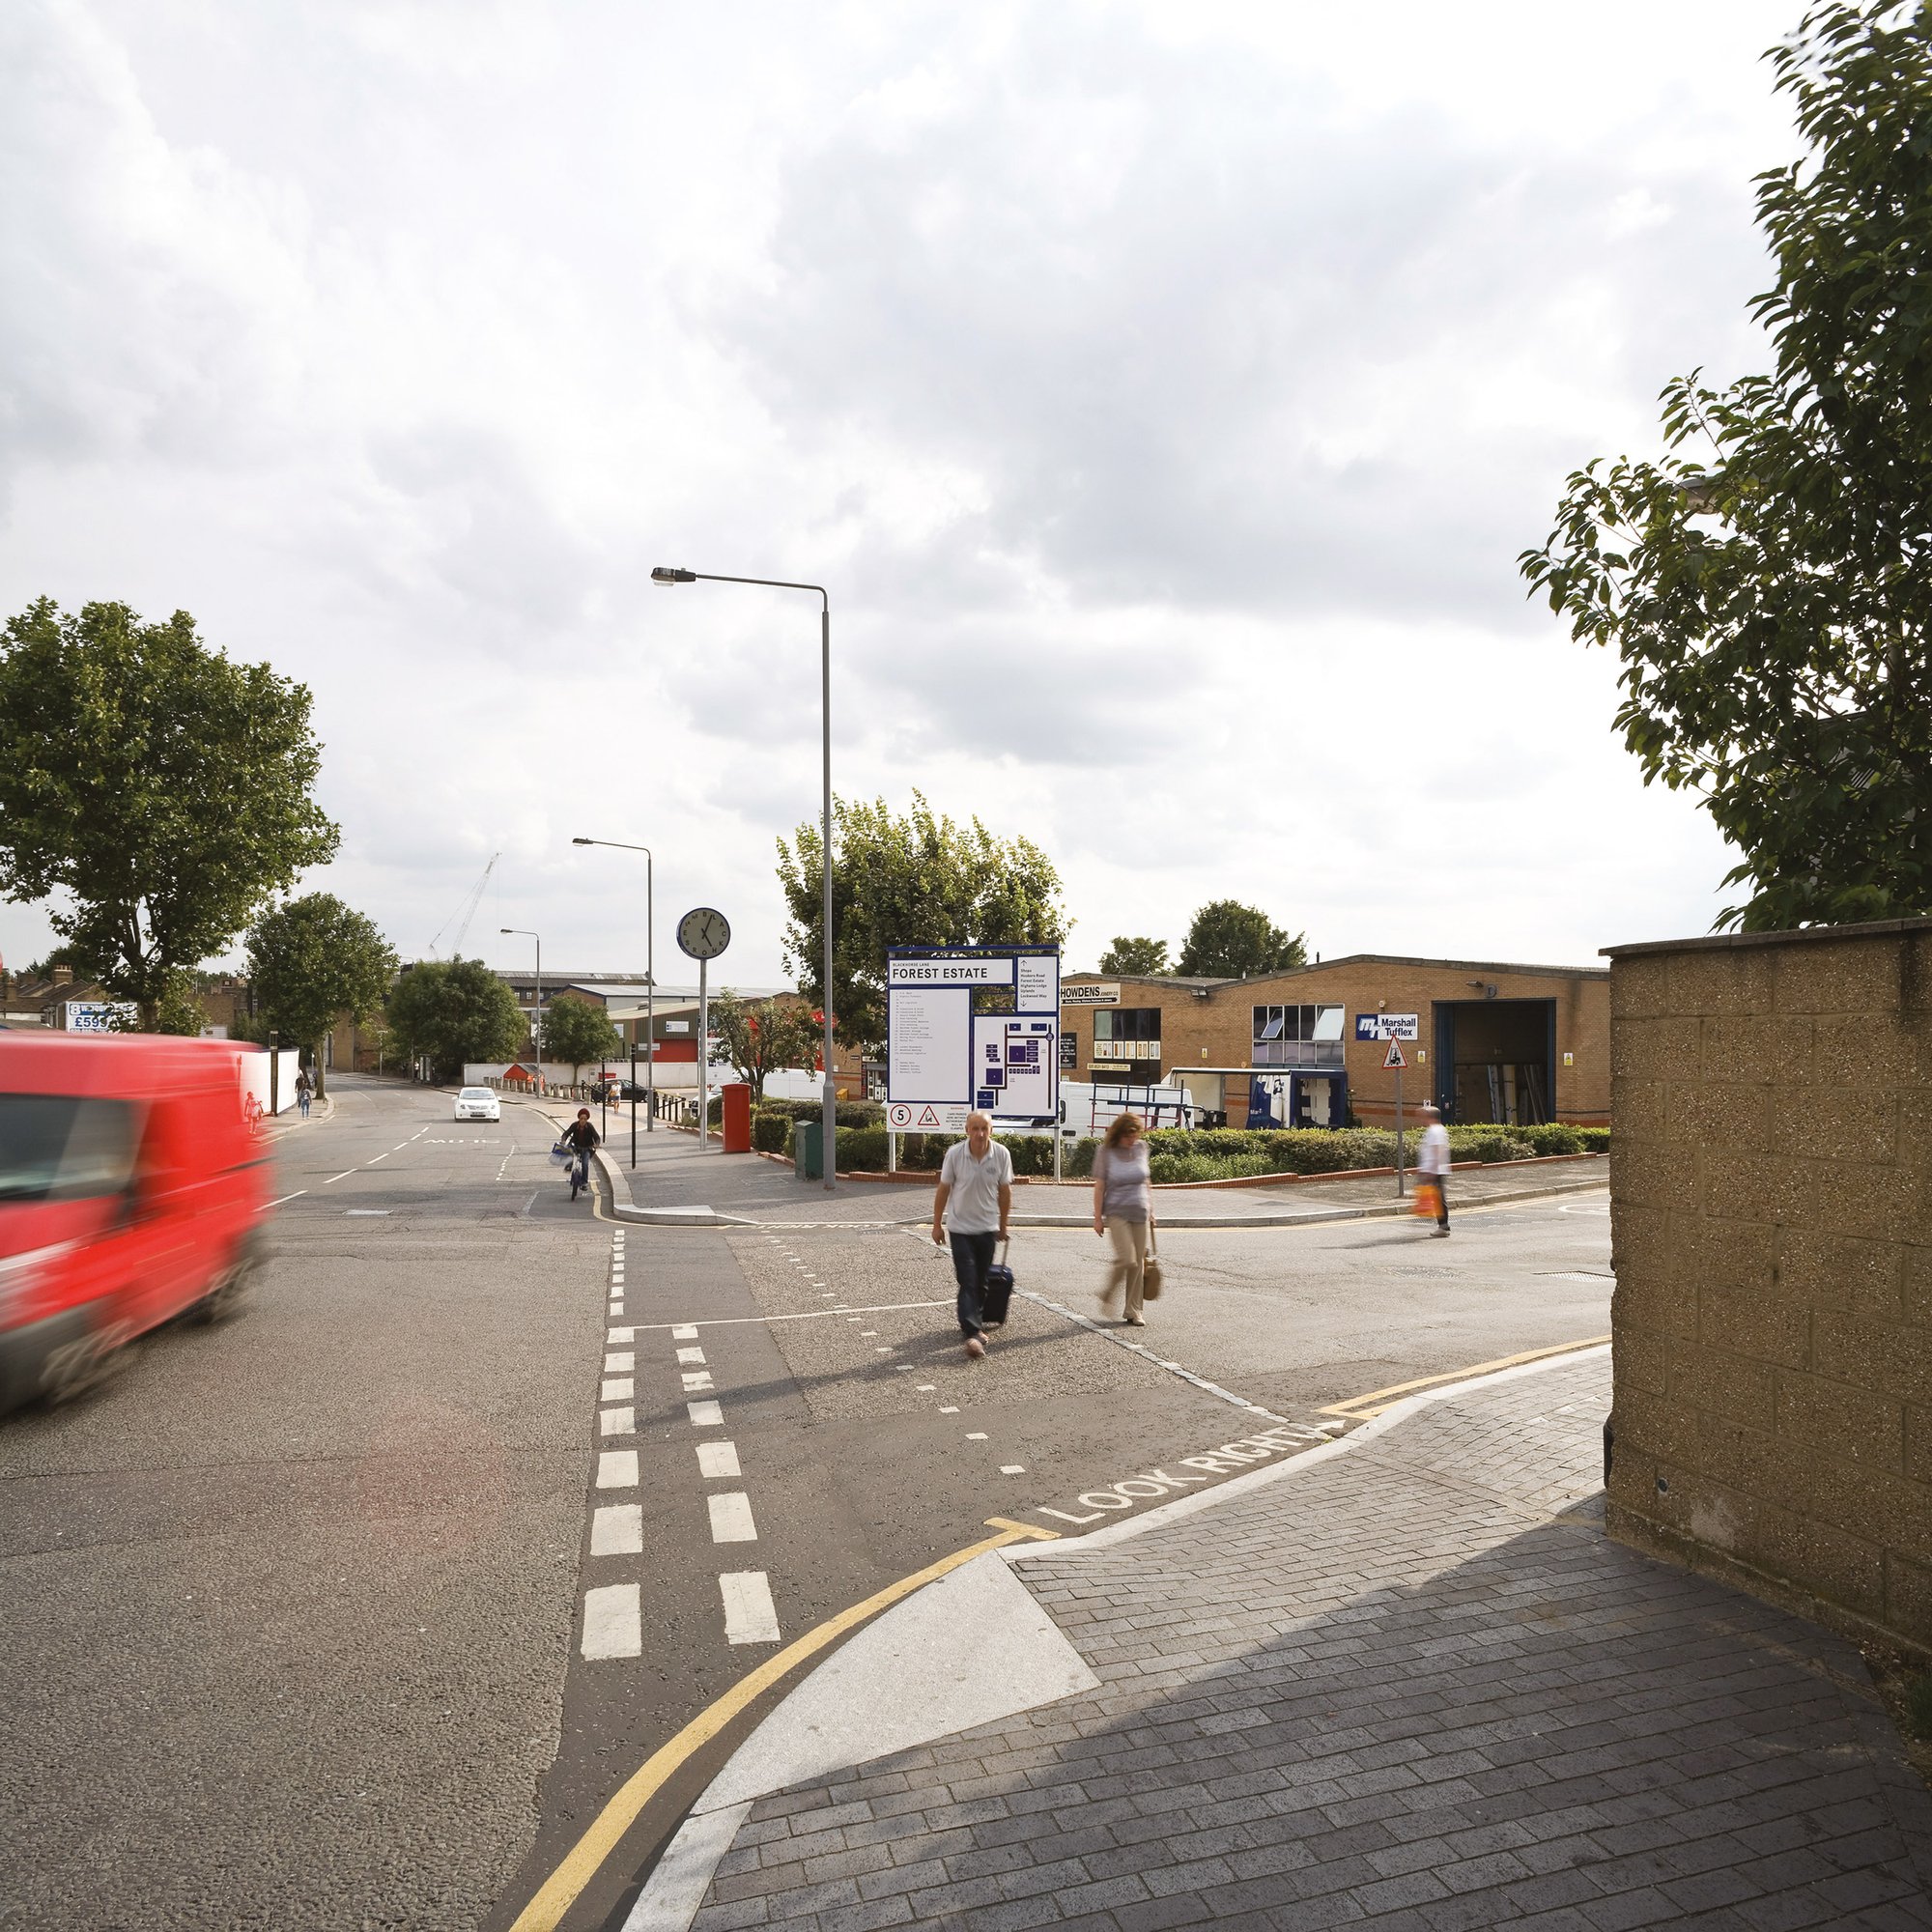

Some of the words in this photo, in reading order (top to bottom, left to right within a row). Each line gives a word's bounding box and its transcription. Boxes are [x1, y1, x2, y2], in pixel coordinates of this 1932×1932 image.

[893, 968, 940, 979] FOREST
[943, 968, 988, 979] ESTATE
[1061, 986, 1100, 998] HOWDENS
[1381, 1018, 1416, 1027] Marshall
[1385, 1028, 1412, 1037] Tufflex
[897, 1110, 904, 1121] 5
[1037, 1469, 1208, 1523] LOOK
[1179, 1427, 1317, 1473] RIGHT
